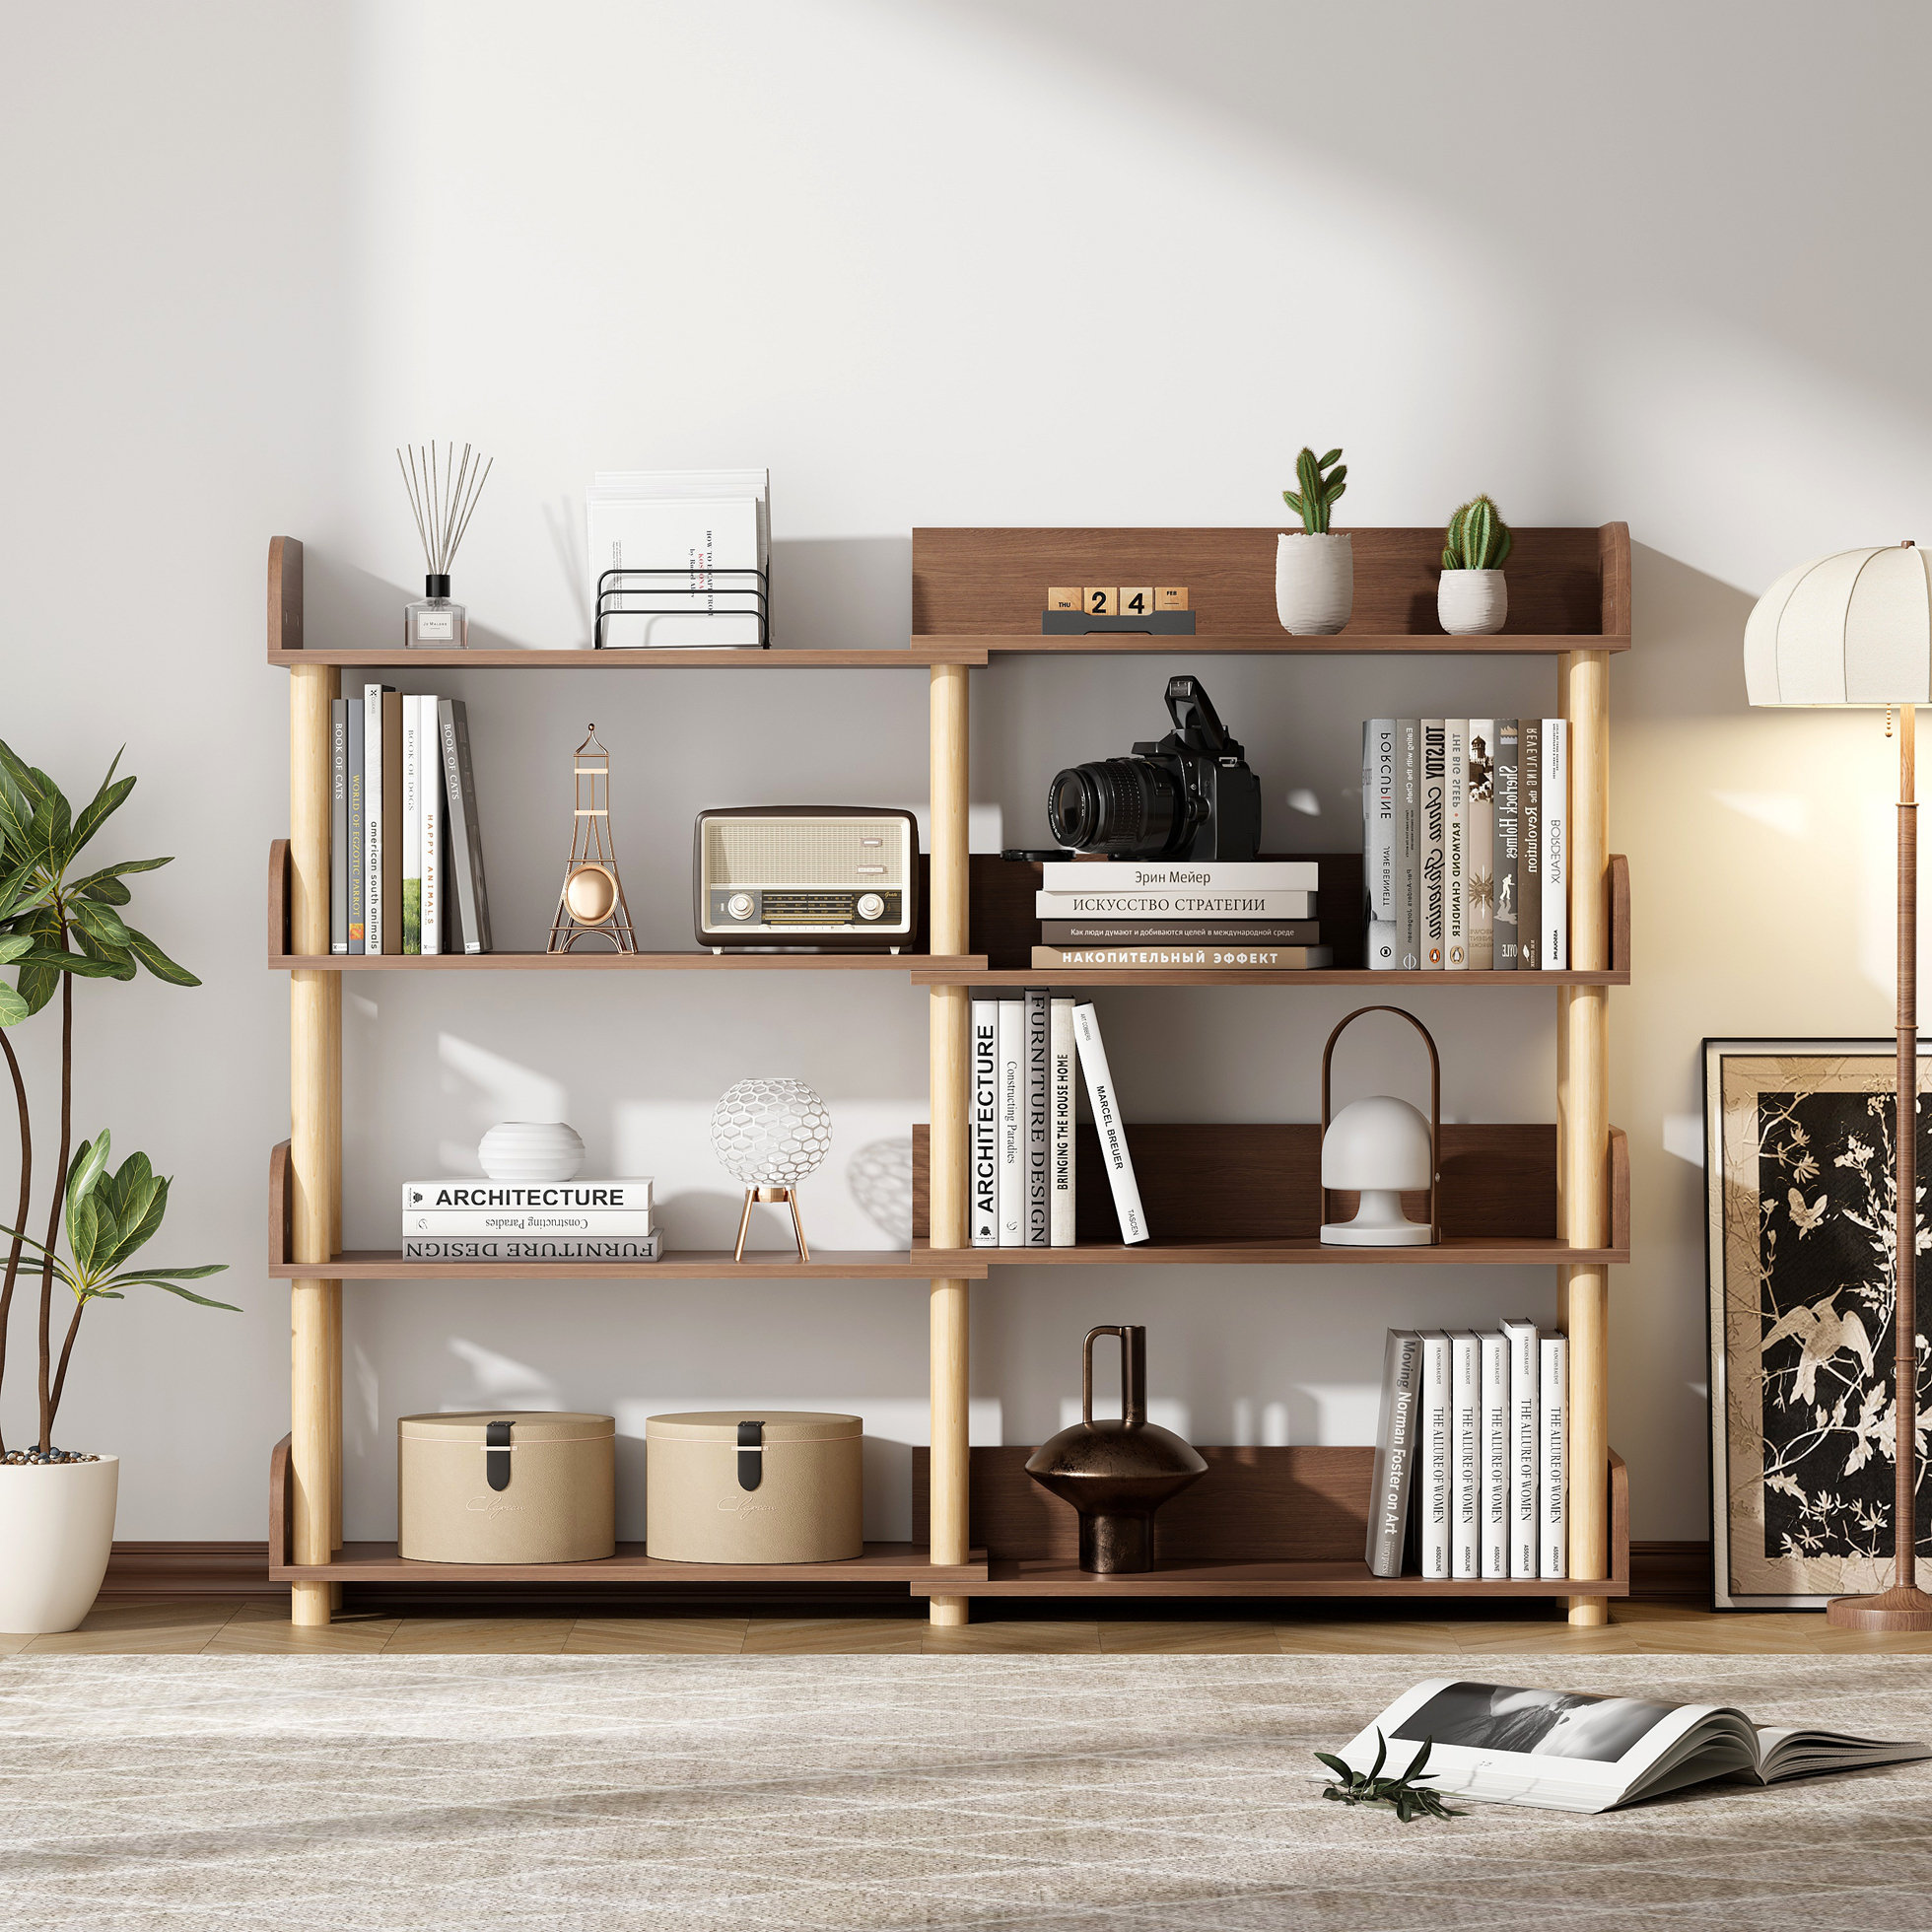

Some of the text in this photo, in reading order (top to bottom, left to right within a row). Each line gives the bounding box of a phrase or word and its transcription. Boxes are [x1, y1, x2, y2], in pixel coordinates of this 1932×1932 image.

[706, 552, 713, 562] TO
[1091, 591, 1107, 614] 2
[1128, 592, 1145, 614] 4
[335, 756, 343, 771] OF
[407, 763, 415, 776] OF
[444, 723, 459, 800] BOOK OF CATS
[353, 814, 361, 828] OF
[352, 831, 361, 875] EGZOTIC
[1135, 870, 1211, 886] Эрин Мейер
[352, 878, 361, 917] PARROT
[371, 821, 380, 949] american south animals
[1072, 898, 1266, 911] ИСКУССТВО СТРАТЕГИИ
[1062, 950, 1278, 964] НАКОПИТЕЛЬНЫЙ ЭФФЕКТ
[1005, 1061, 1018, 1122] Constructing
[977, 1025, 994, 1214] ARCHITECTURE
[1031, 996, 1045, 1243] FURNITURE DESIGN
[1057, 1054, 1069, 1190] BRINGING THE HOUSE HOME
[1096, 1085, 1124, 1170] MARCEL BREUER
[435, 1189, 624, 1206] ARCHITECTURE
[527, 1215, 588, 1230] Constructing
[406, 1242, 654, 1258] FURNITURE DESIGN
[1384, 1341, 1416, 1535] Moving Norman Foster on Art
[1521, 1398, 1532, 1521] THE ALLURE OF WOMEN
[1433, 1407, 1444, 1524] THE ALLURE OF WOMEN
[1462, 1407, 1473, 1524] THE ALLURE OF WOMEN
[1491, 1407, 1502, 1524] THE ALLURE OF WOMEN
[1551, 1407, 1561, 1524] THE ALLURE OF WOMEN
